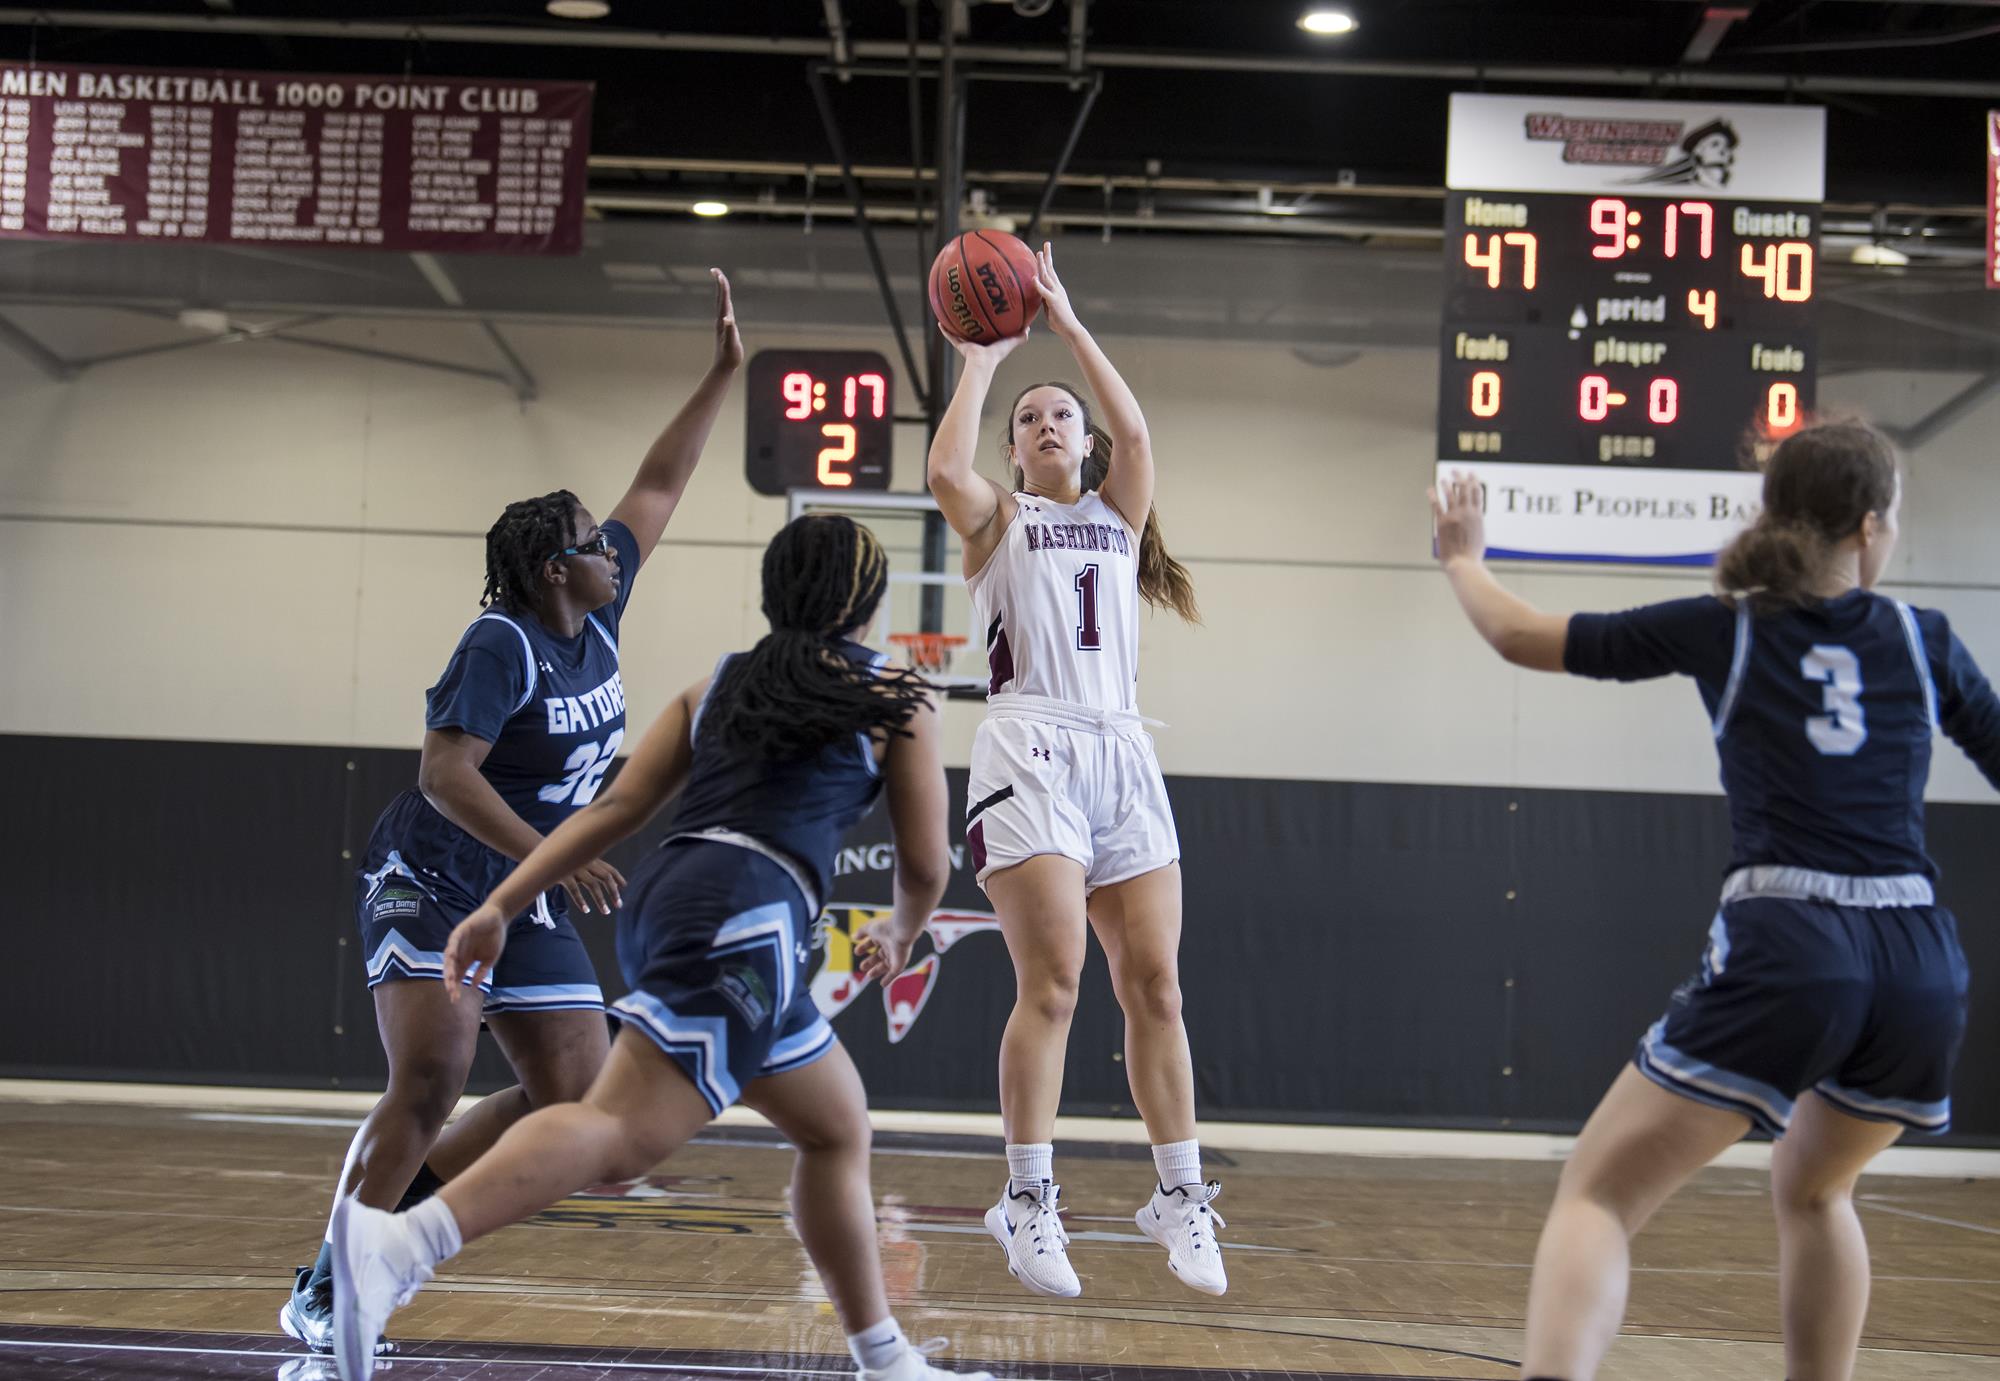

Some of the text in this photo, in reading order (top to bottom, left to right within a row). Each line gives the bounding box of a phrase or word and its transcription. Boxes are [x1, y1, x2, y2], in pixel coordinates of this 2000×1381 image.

[2, 70, 539, 113] MEN BASKETBALL 1000 POINT CLUB
[1526, 113, 1683, 143] WASHINGTON
[1563, 142, 1667, 165] COLLEGE
[1464, 197, 1528, 227] Home
[1590, 199, 1713, 259] 9:17
[1733, 206, 1811, 238] Guests
[1465, 233, 1537, 290] 47
[1741, 242, 1813, 302] 40
[976, 261, 1011, 316] NCAA
[1687, 289, 1716, 329] 4
[1597, 295, 1666, 326] period
[1456, 332, 1509, 361] fouls
[1594, 336, 1667, 367] player
[1752, 343, 1805, 372] fouls
[783, 373, 885, 419] 9:17
[1471, 371, 1500, 417] 0
[1649, 378, 1678, 423] 0
[1768, 383, 1797, 427] 0
[817, 424, 856, 486] 2
[1599, 435, 1655, 461] game
[1499, 486, 1760, 521] THE PEOPLES BA
[1075, 563, 1101, 651] 1
[1800, 643, 1868, 757] 3
[538, 727, 624, 806] 32
[395, 900, 417, 909] DAME
